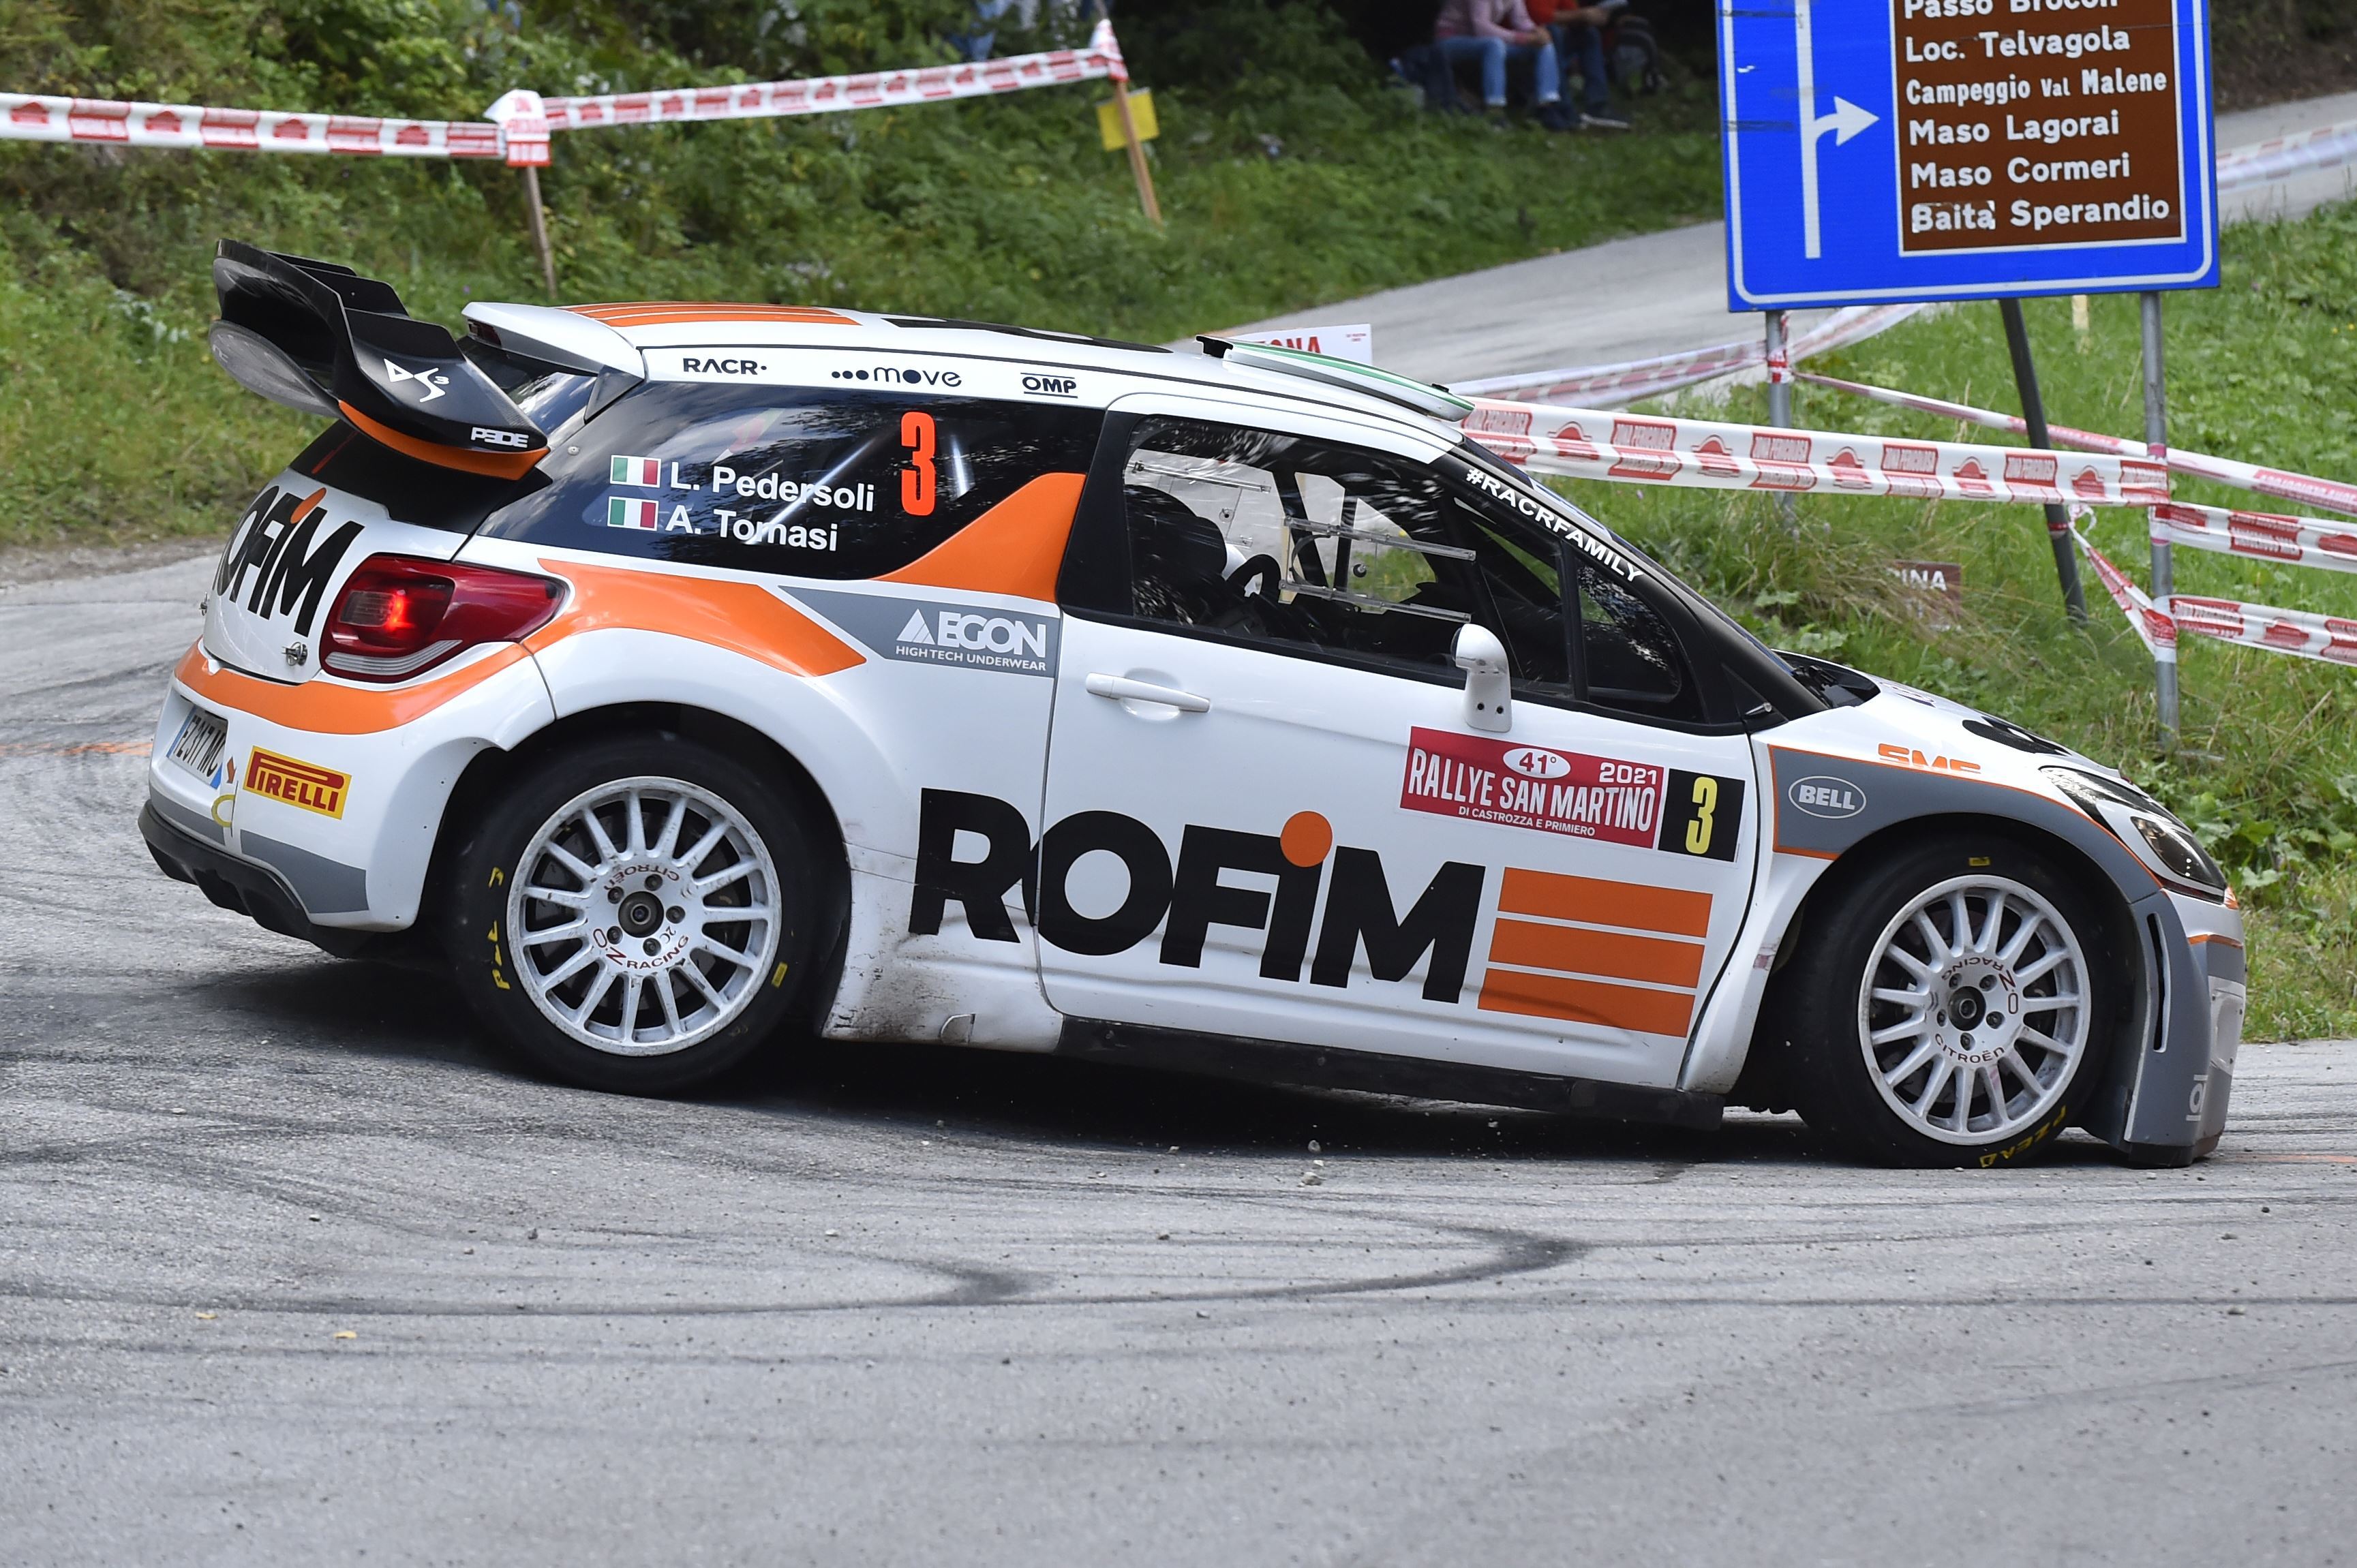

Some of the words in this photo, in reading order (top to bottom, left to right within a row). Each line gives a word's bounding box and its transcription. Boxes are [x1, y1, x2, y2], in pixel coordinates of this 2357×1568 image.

[1904, 0, 1993, 19] Passo
[1906, 36, 1965, 62] Loc.
[1978, 25, 2130, 59] Telvagola
[1906, 74, 2031, 107] Campeggio
[2041, 77, 2071, 97] Val
[2081, 67, 2168, 95] Malene
[1909, 119, 1990, 146] Maso
[2006, 109, 2119, 144] Lagorai
[1911, 162, 1992, 188] Maso
[2007, 152, 2130, 183] Cormeri
[2010, 194, 2170, 230] Sperandio
[1022, 376, 1077, 394] OMP
[901, 412, 935, 516] 3
[670, 461, 701, 491] L.
[712, 465, 875, 512] Pedersoli
[665, 504, 701, 535] A.
[713, 508, 838, 552] Tomasi
[1466, 468, 1644, 583] #RACRFAMILY
[896, 645, 928, 658] HIGH
[929, 649, 963, 662] TECH
[967, 654, 1046, 671] UNDERWEAR
[246, 751, 345, 812] PIRELLI
[1408, 748, 1495, 807] RALLYE
[1500, 776, 1547, 815] SAN
[1549, 784, 1656, 833] MARTINO
[1599, 762, 1657, 785] 2021
[1799, 784, 1855, 810] BELL
[1459, 806, 1470, 816] DI
[1472, 808, 1534, 827] CASTROZZA
[1536, 819, 1543, 828] E
[1545, 820, 1596, 837] PRIMIERO
[1685, 776, 1718, 855] 3
[626, 935, 689, 970] RACING
[1942, 957, 2004, 981] RACING
